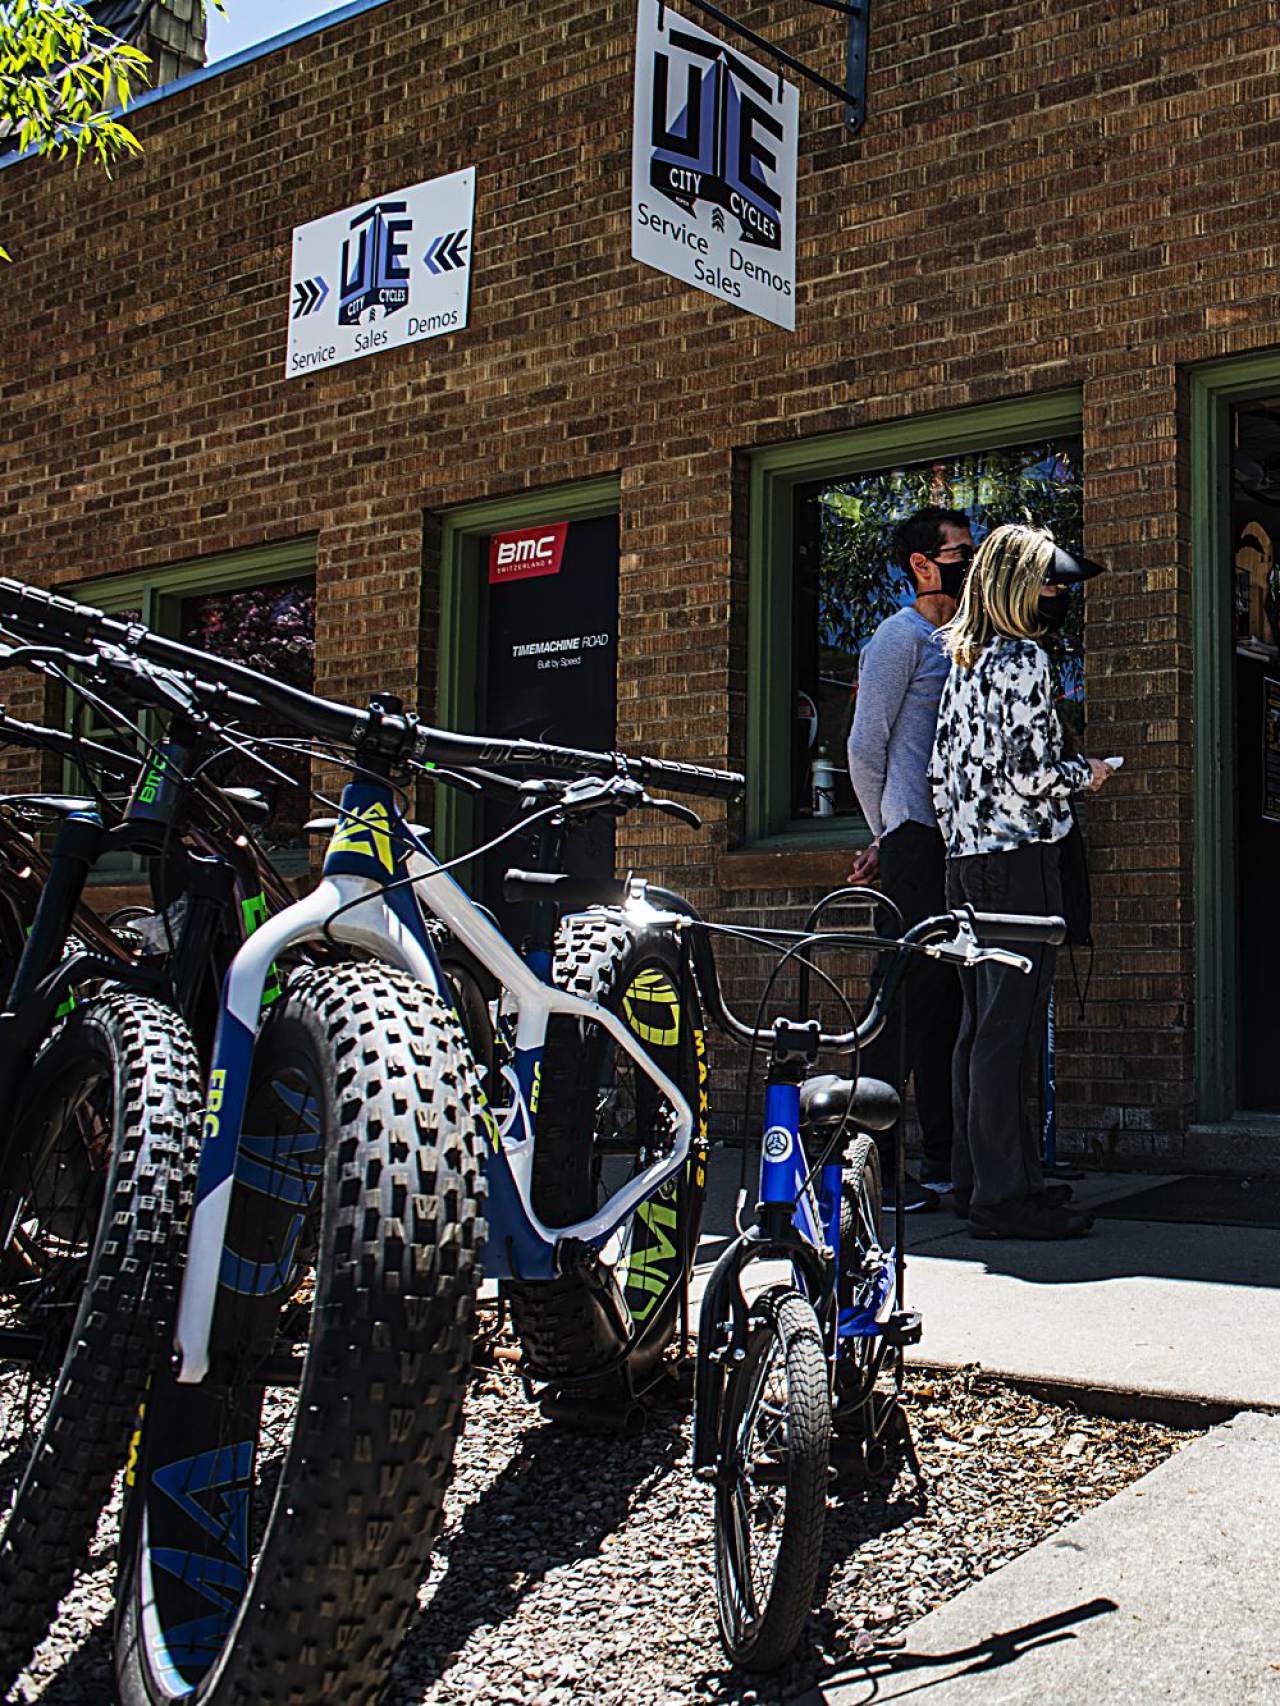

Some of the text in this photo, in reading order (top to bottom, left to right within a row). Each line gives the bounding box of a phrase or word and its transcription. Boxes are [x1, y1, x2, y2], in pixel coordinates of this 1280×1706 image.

[669, 168, 776, 241] CITY CYCLES
[637, 201, 792, 296] Service Demos
[694, 258, 742, 299] Sales
[347, 288, 406, 317] CITY CYCLES
[291, 308, 458, 372] Service Sales Demos
[497, 535, 556, 565] BMC
[496, 560, 545, 574] SWITZERLAND
[511, 633, 609, 658] TIMEMACHINE ROAD
[537, 655, 582, 670] Built by Speed
